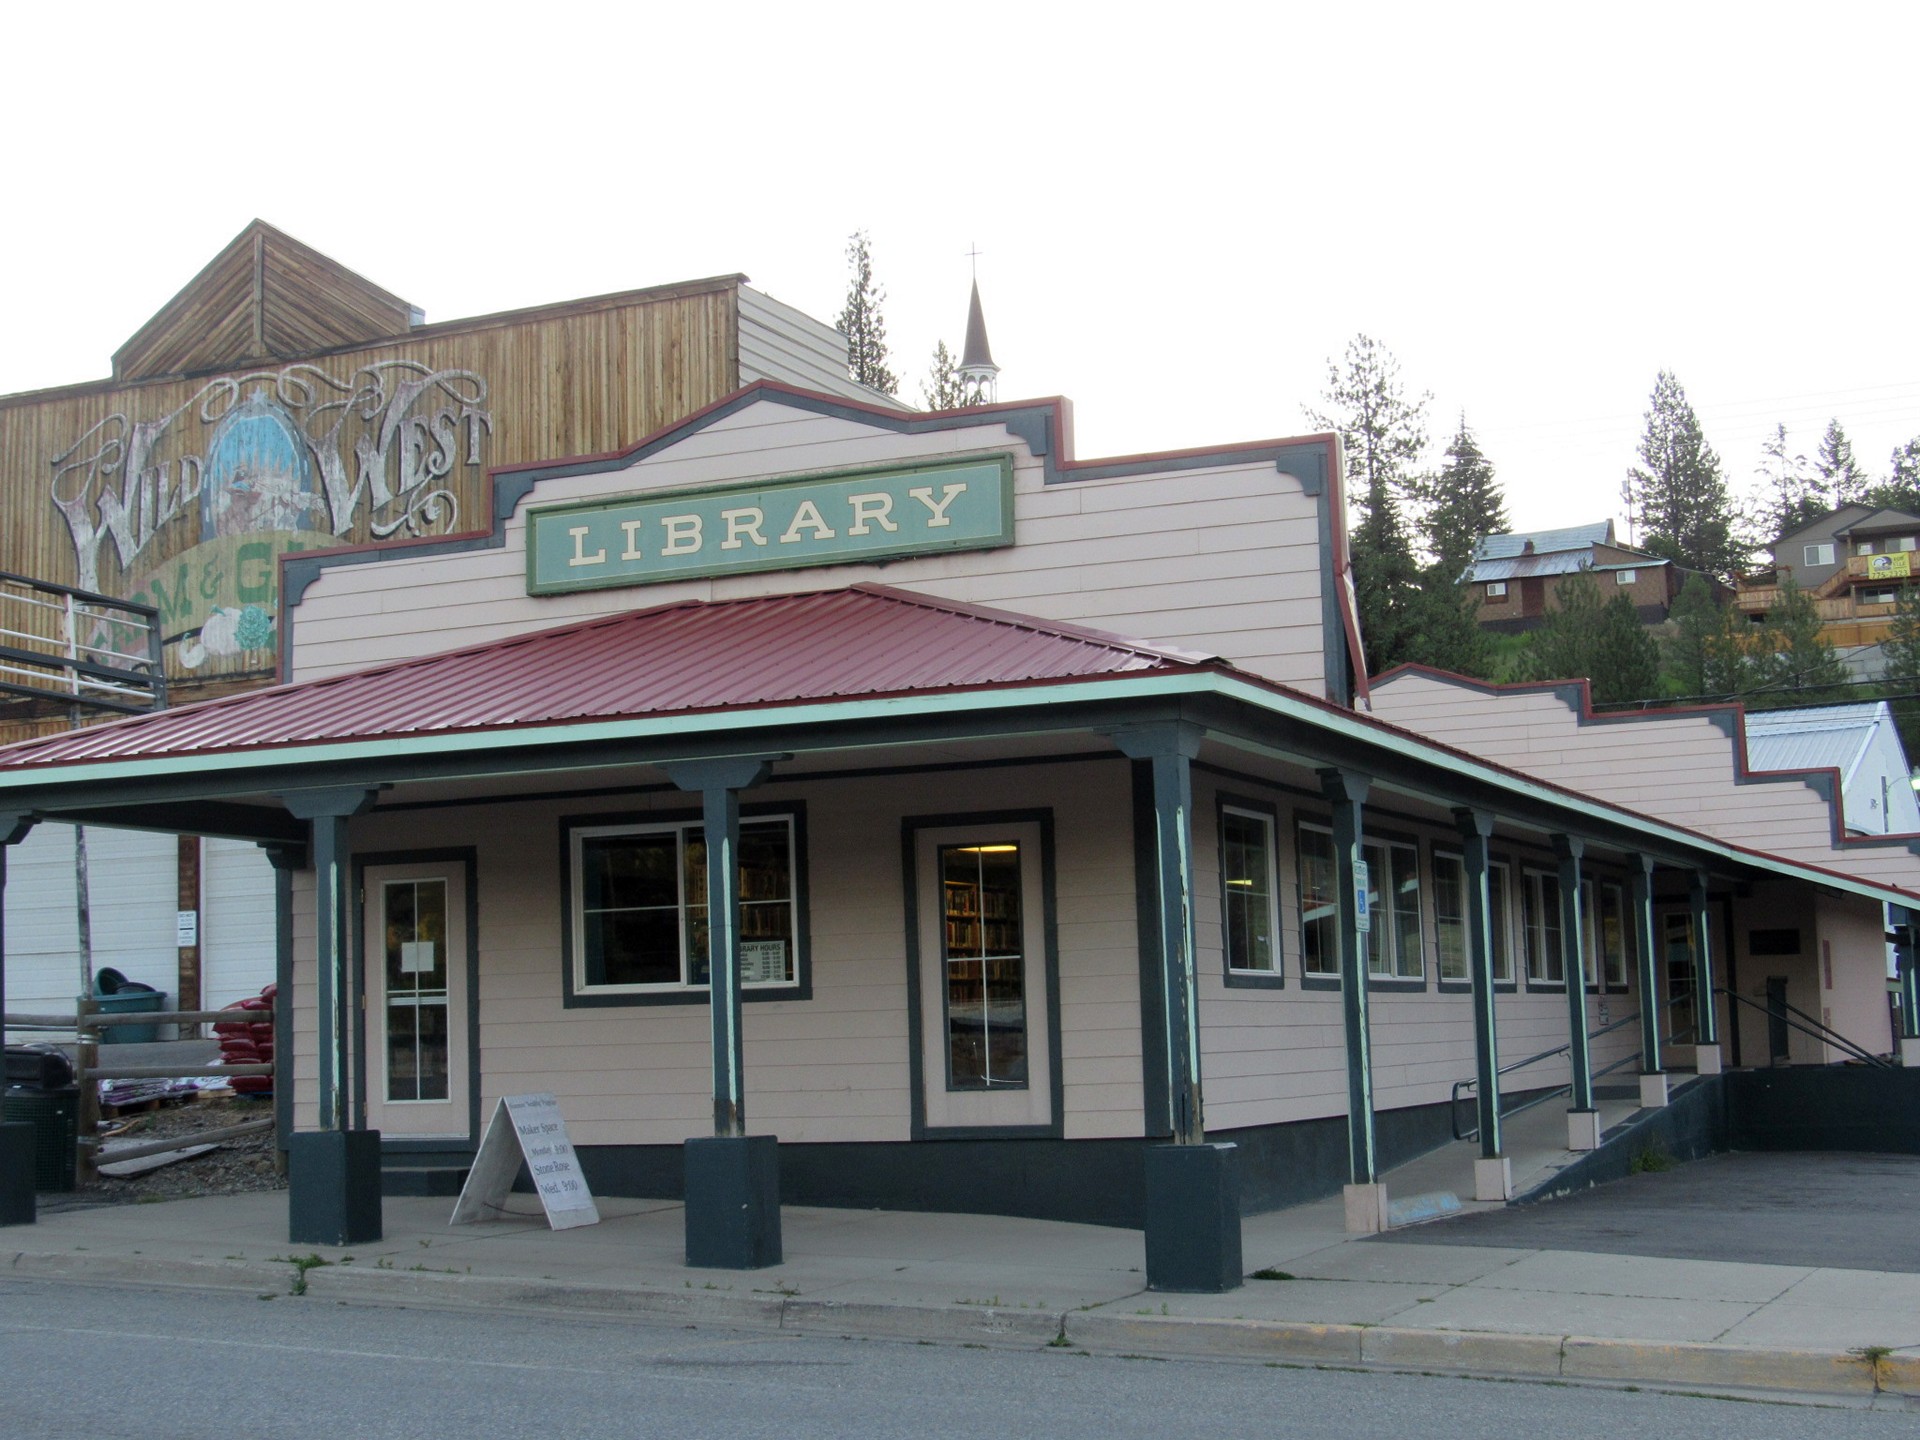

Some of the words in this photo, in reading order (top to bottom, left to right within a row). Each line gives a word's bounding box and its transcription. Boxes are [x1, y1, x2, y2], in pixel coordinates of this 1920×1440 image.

[568, 482, 968, 568] LIBRARY
[203, 554, 224, 600] &
[519, 1123, 540, 1135] Maker
[540, 1122, 559, 1135] Space
[534, 1163, 554, 1175] Stone
[553, 1160, 571, 1172] Rose
